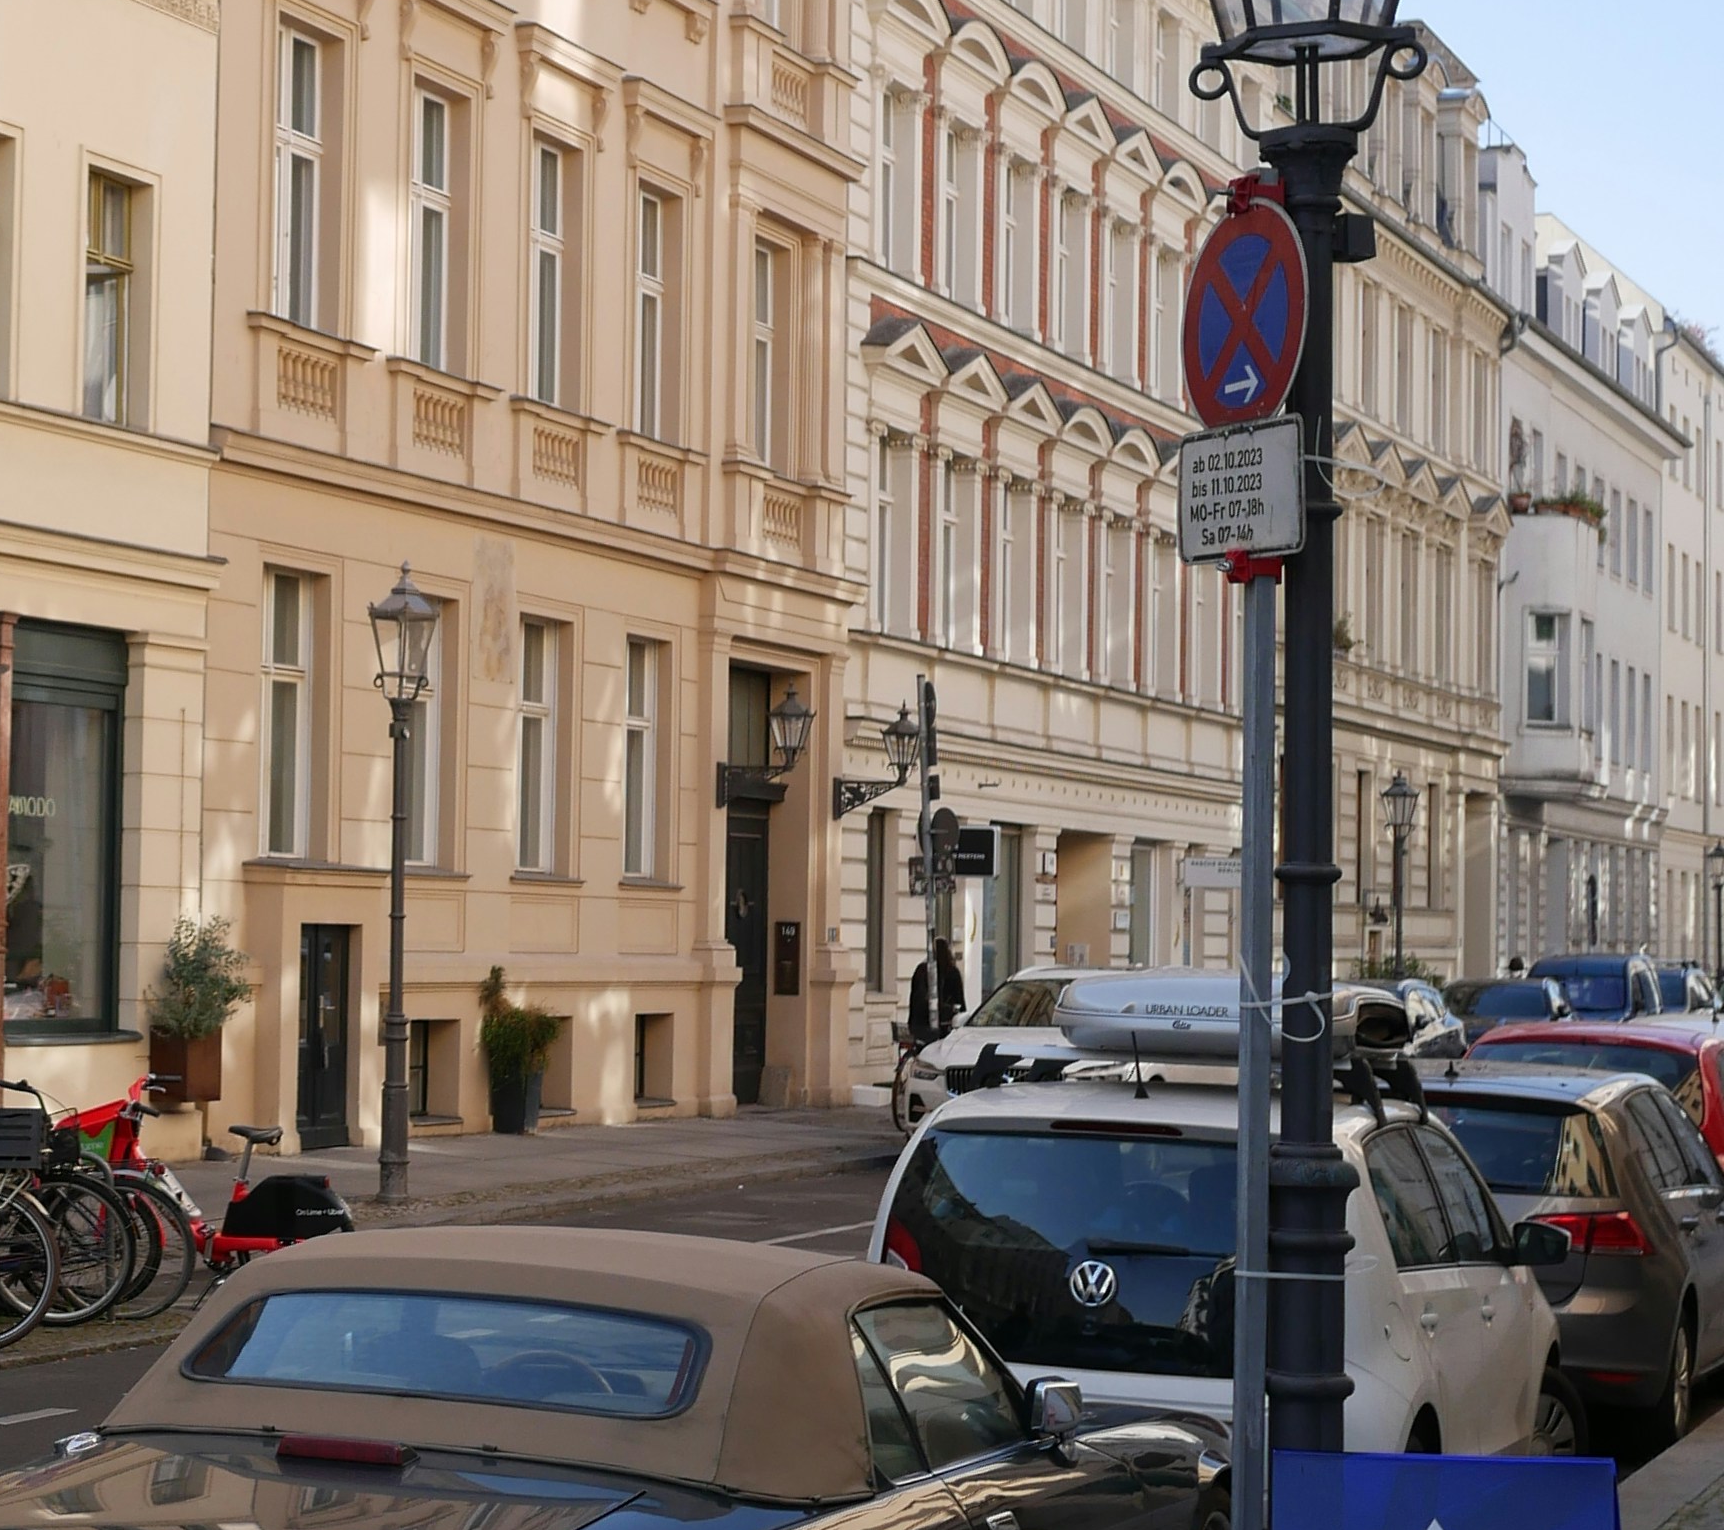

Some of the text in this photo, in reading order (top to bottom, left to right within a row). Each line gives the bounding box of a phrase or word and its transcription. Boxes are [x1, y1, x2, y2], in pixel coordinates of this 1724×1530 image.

[1192, 447, 1263, 474] ab 02.10.2023
[1192, 473, 1262, 498] bis 11.10.2023
[1190, 498, 1264, 523] MO-Fr 07-18h
[1201, 524, 1254, 546] Sa 07-14h
[1145, 1003, 1229, 1017] URBAN LOADER
